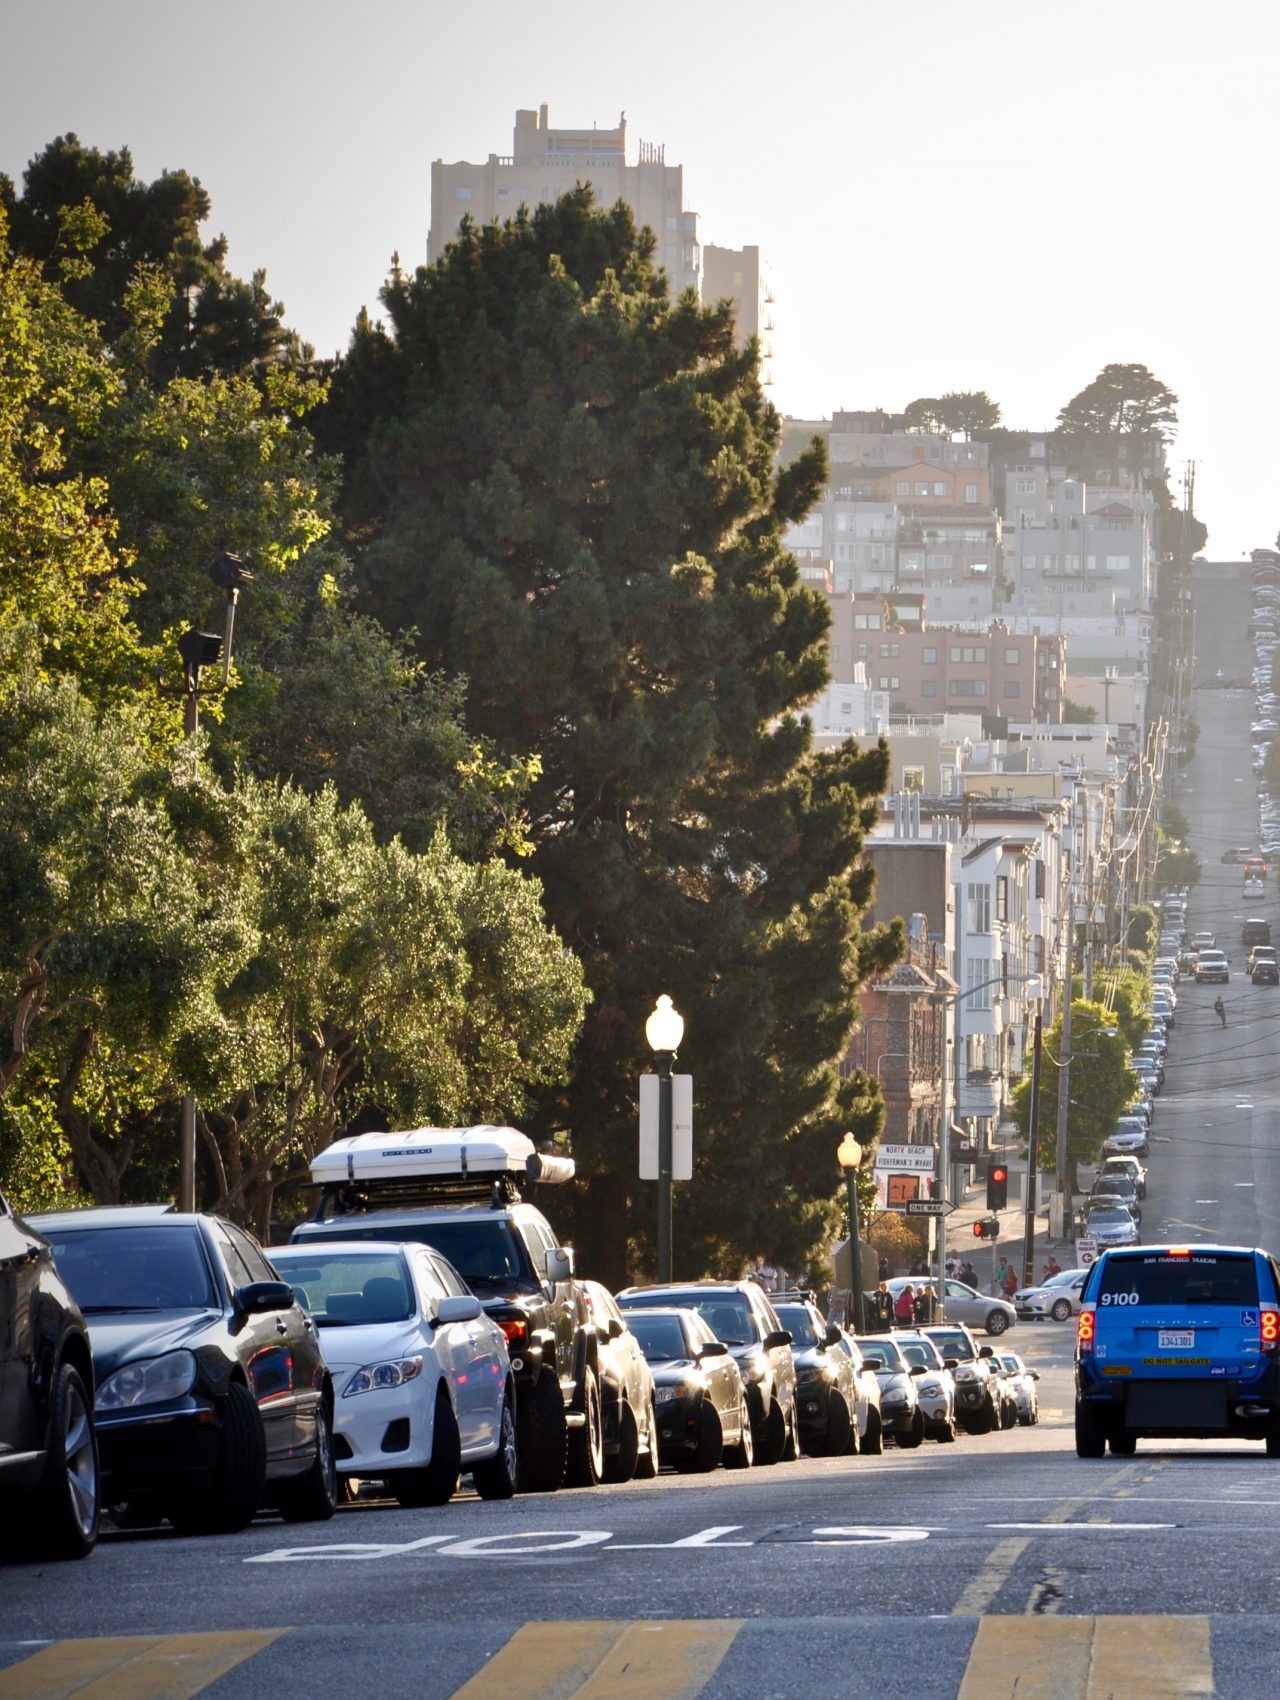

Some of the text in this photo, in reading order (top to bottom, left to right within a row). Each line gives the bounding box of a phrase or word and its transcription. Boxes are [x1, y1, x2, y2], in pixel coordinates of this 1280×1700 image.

[885, 1146, 926, 1155] NORTH BEACH
[914, 1159, 932, 1167] WHARF
[1101, 1292, 1139, 1306] 9100
